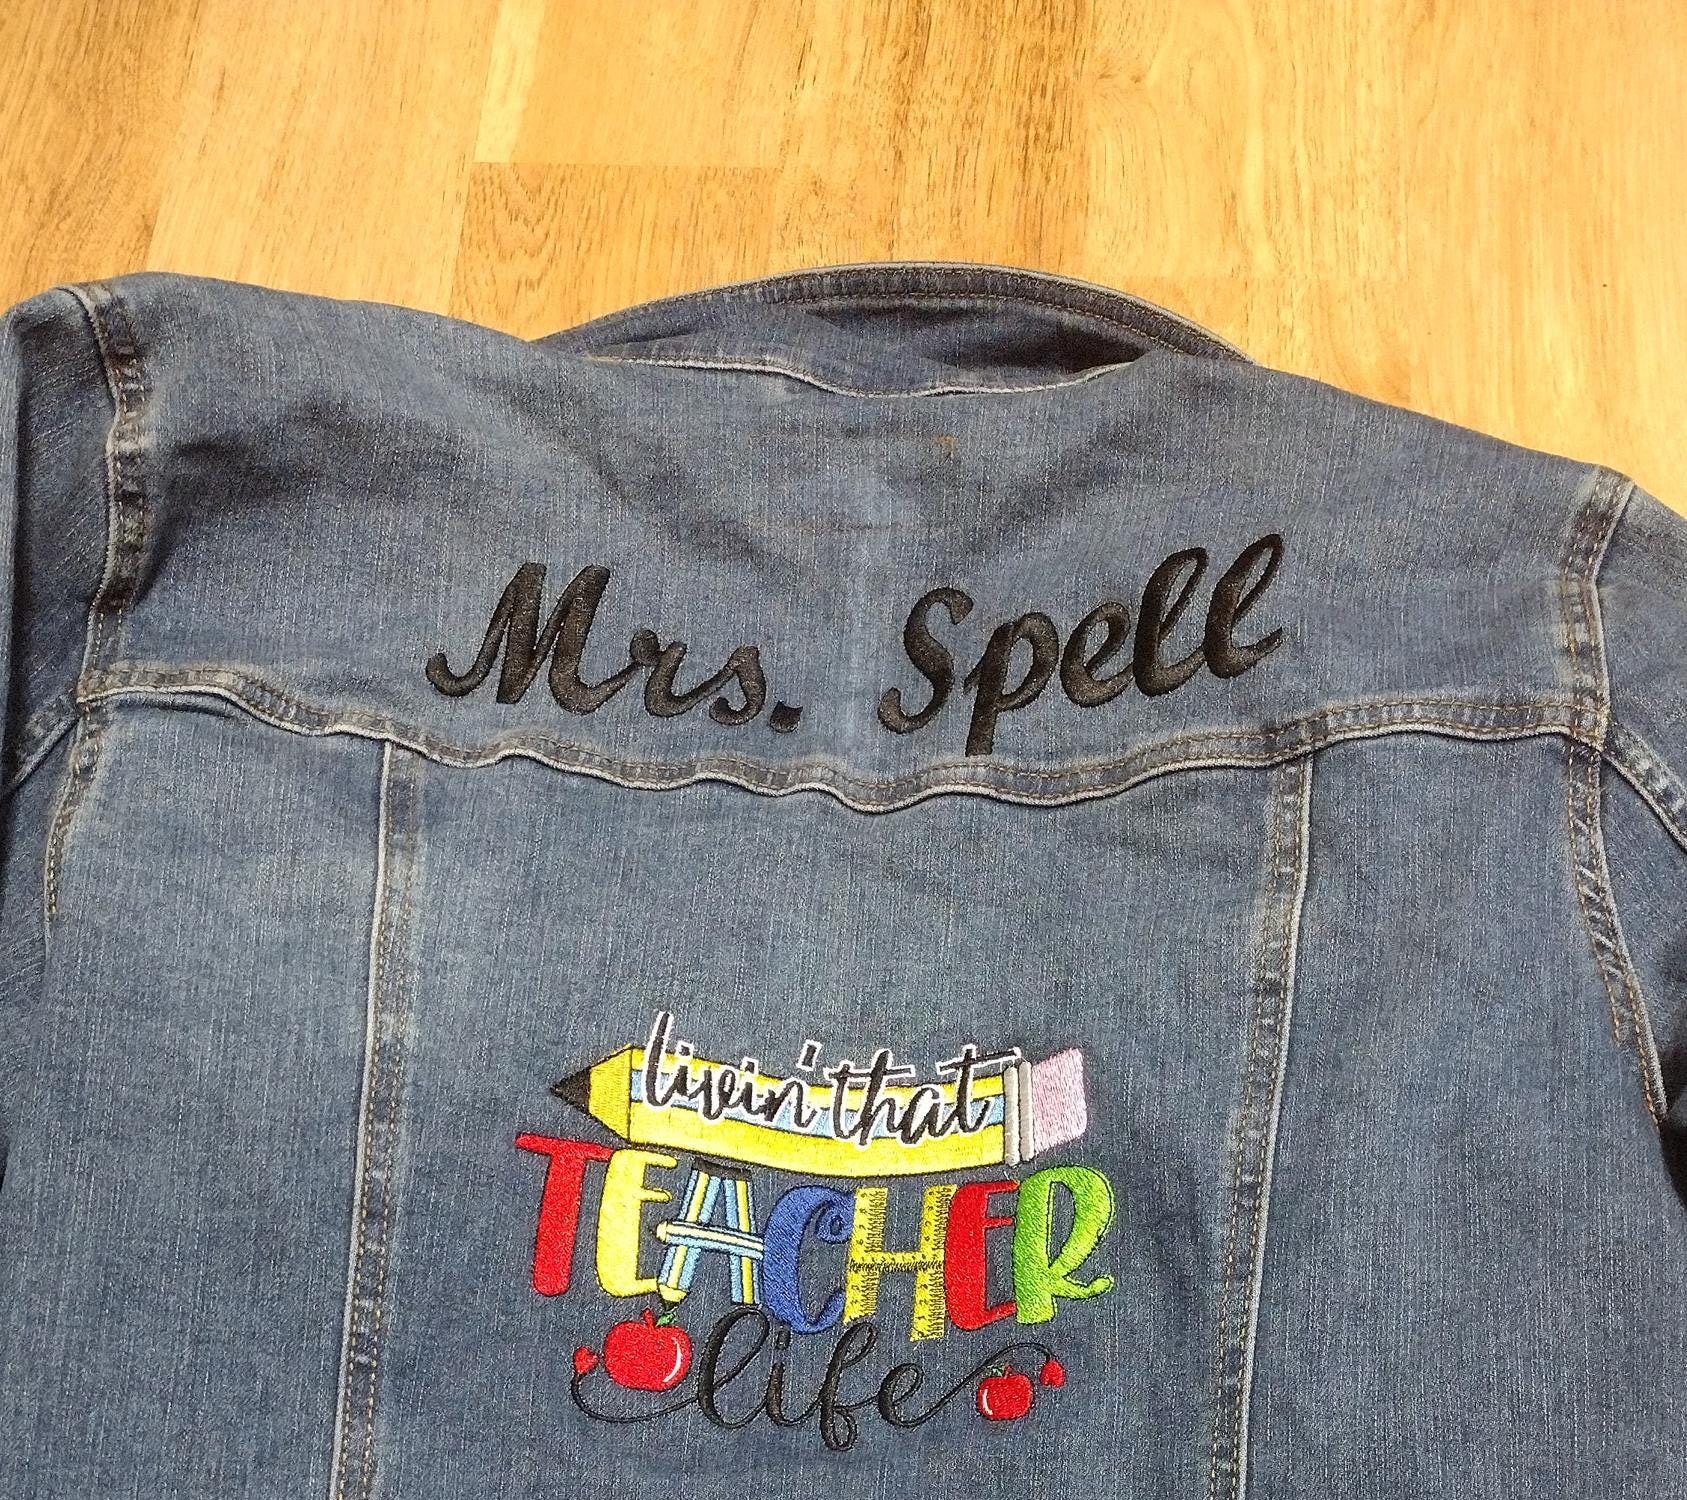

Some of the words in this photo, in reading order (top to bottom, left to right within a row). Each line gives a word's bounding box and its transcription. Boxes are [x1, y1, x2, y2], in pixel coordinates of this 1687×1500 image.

[425, 563, 804, 735] Mrs.
[877, 532, 1284, 757] Spell
[828, 1045, 1022, 1148] that
[515, 1132, 1116, 1342] TEACHER
[698, 1306, 935, 1452] life
